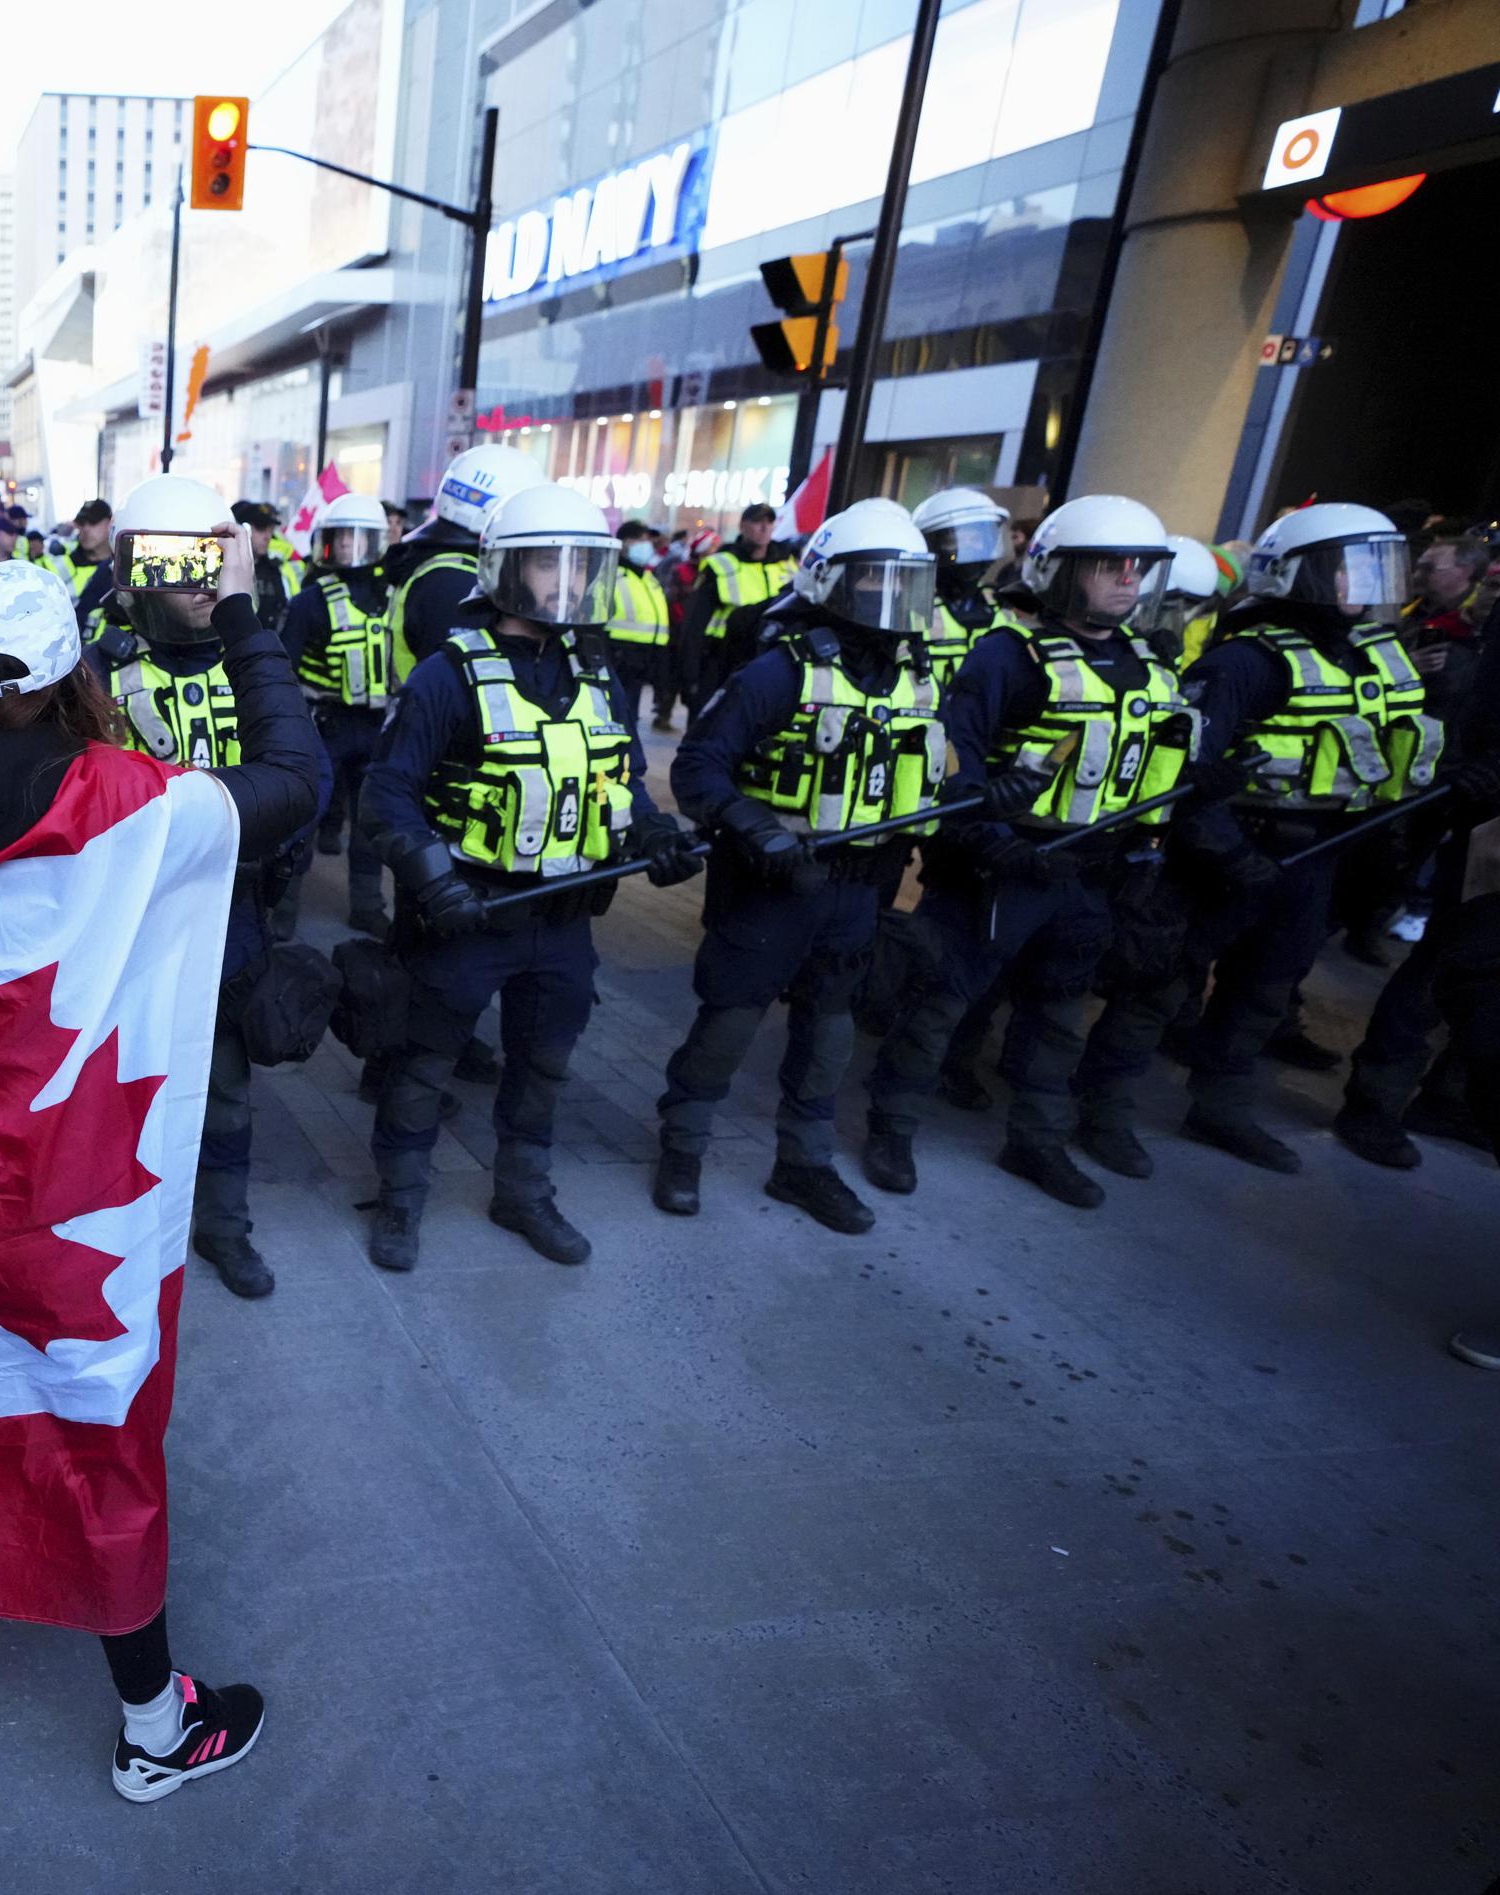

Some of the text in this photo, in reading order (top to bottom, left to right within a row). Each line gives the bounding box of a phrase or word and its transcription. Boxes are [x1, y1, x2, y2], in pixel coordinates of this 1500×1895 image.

[483, 143, 689, 303] LD NAVY
[472, 469, 497, 488] 117
[556, 466, 791, 508] OKYO SMOKE
[192, 738, 211, 760] A
[1123, 743, 1141, 763] A
[869, 762, 886, 777] A
[1120, 761, 1139, 779] 12
[868, 777, 884, 797] 12
[560, 794, 578, 814] A
[560, 814, 578, 833] 12
